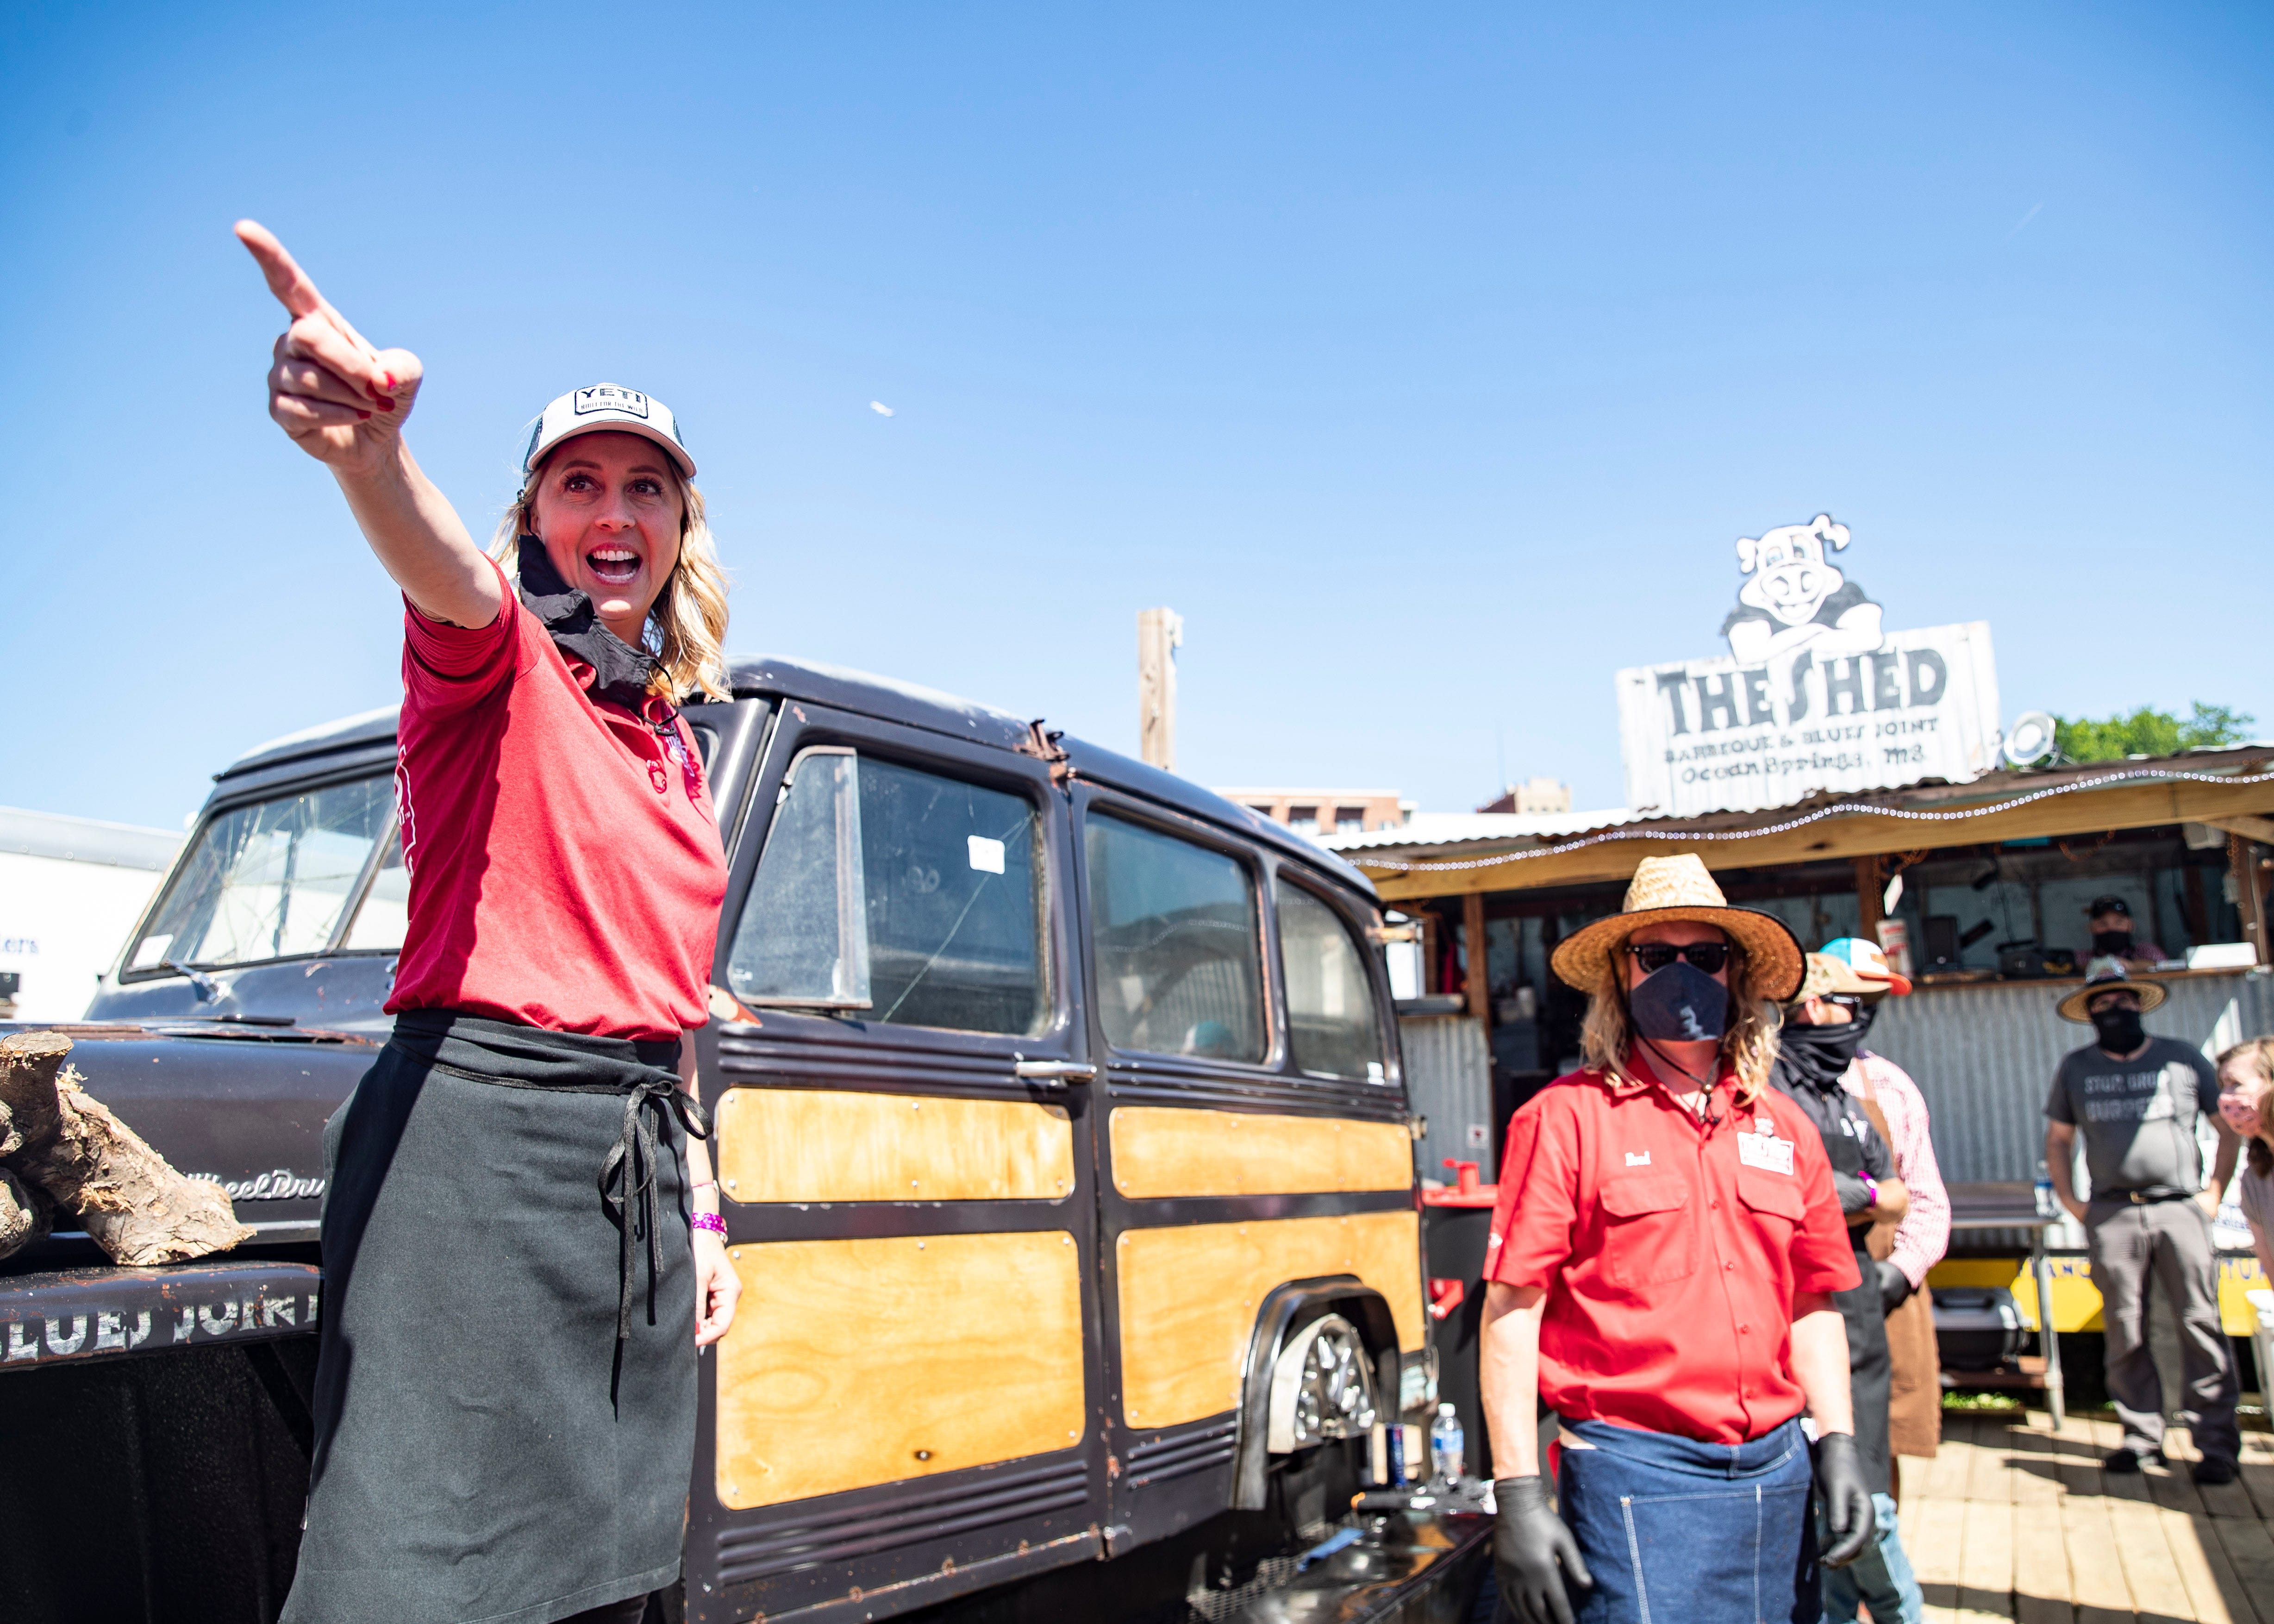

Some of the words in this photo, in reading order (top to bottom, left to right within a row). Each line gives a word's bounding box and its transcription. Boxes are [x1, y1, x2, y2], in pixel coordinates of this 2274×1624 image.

[581, 388, 641, 403] YETI
[1656, 669, 1777, 735] THE
[1786, 647, 1947, 725] SHED
[1875, 718, 1938, 738] JOINT
